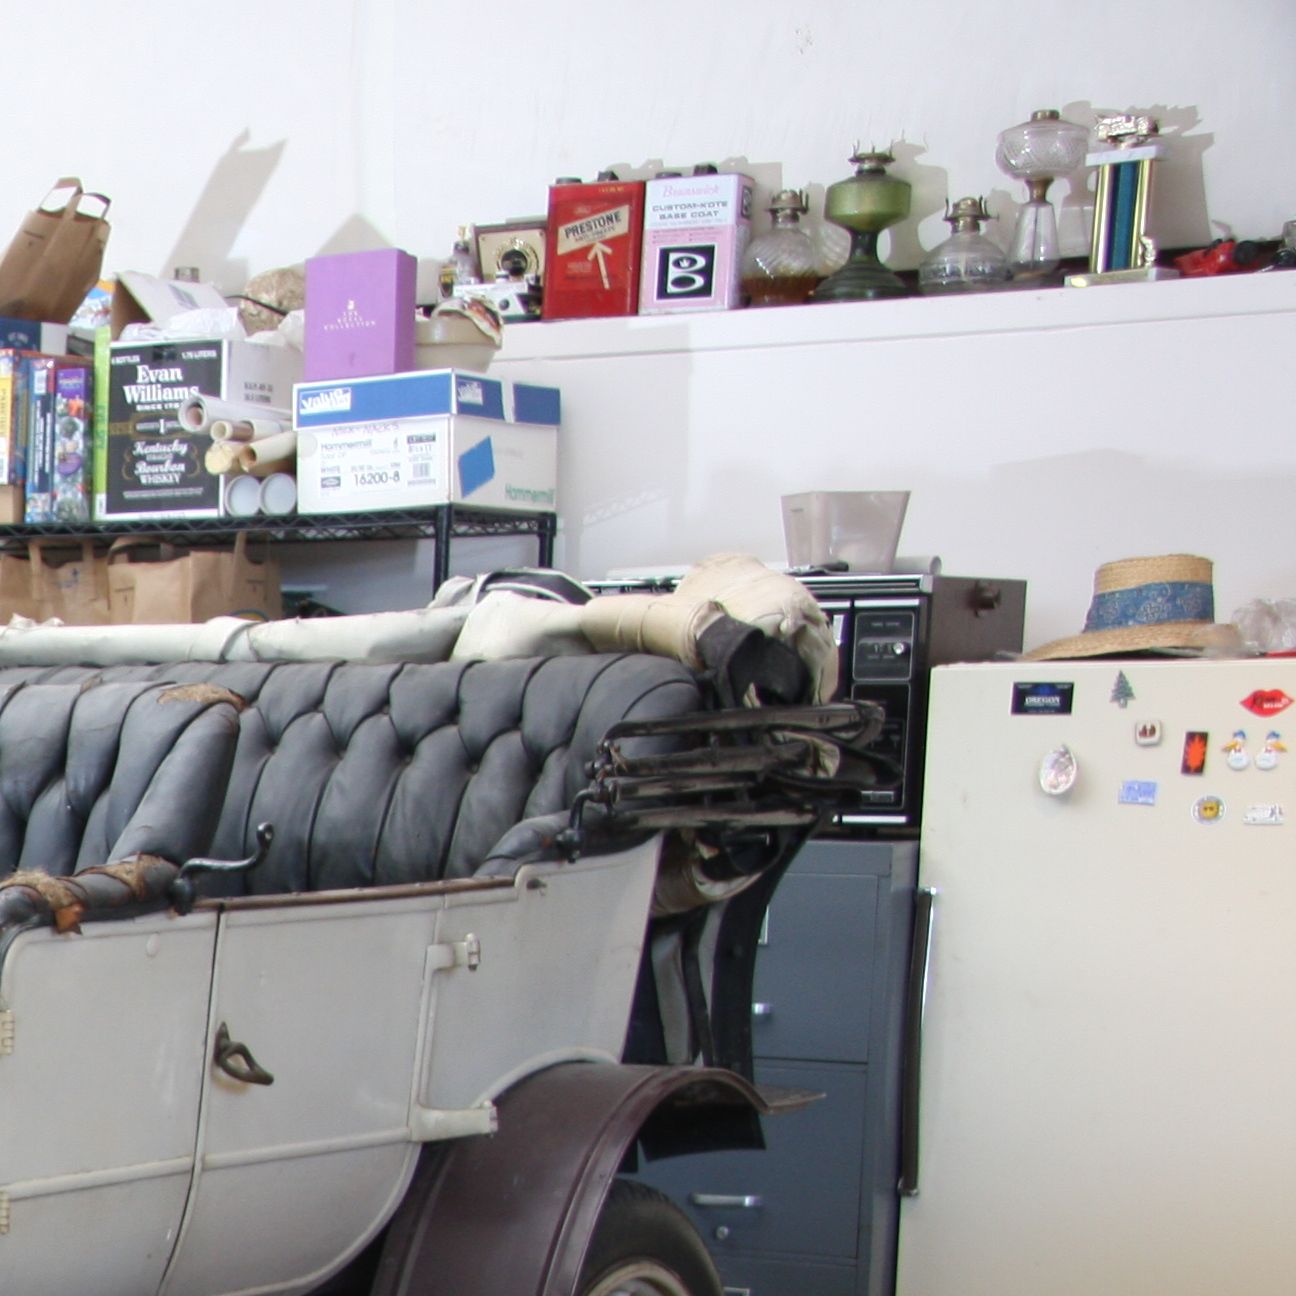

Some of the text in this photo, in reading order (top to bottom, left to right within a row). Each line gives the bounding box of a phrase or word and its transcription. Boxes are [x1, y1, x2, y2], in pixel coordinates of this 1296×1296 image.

[659, 210, 720, 220] BASE COAT
[564, 210, 622, 239] PRESTONE
[666, 252, 706, 294] B
[136, 365, 183, 384] Evan
[123, 384, 200, 404] Williams
[132, 439, 188, 455] Kentucky
[320, 438, 373, 450] Hammermill
[134, 460, 185, 475] Bourbon
[140, 474, 181, 485] WHISKEY
[353, 470, 400, 487] 16200-8
[1025, 695, 1061, 705] OREGON
